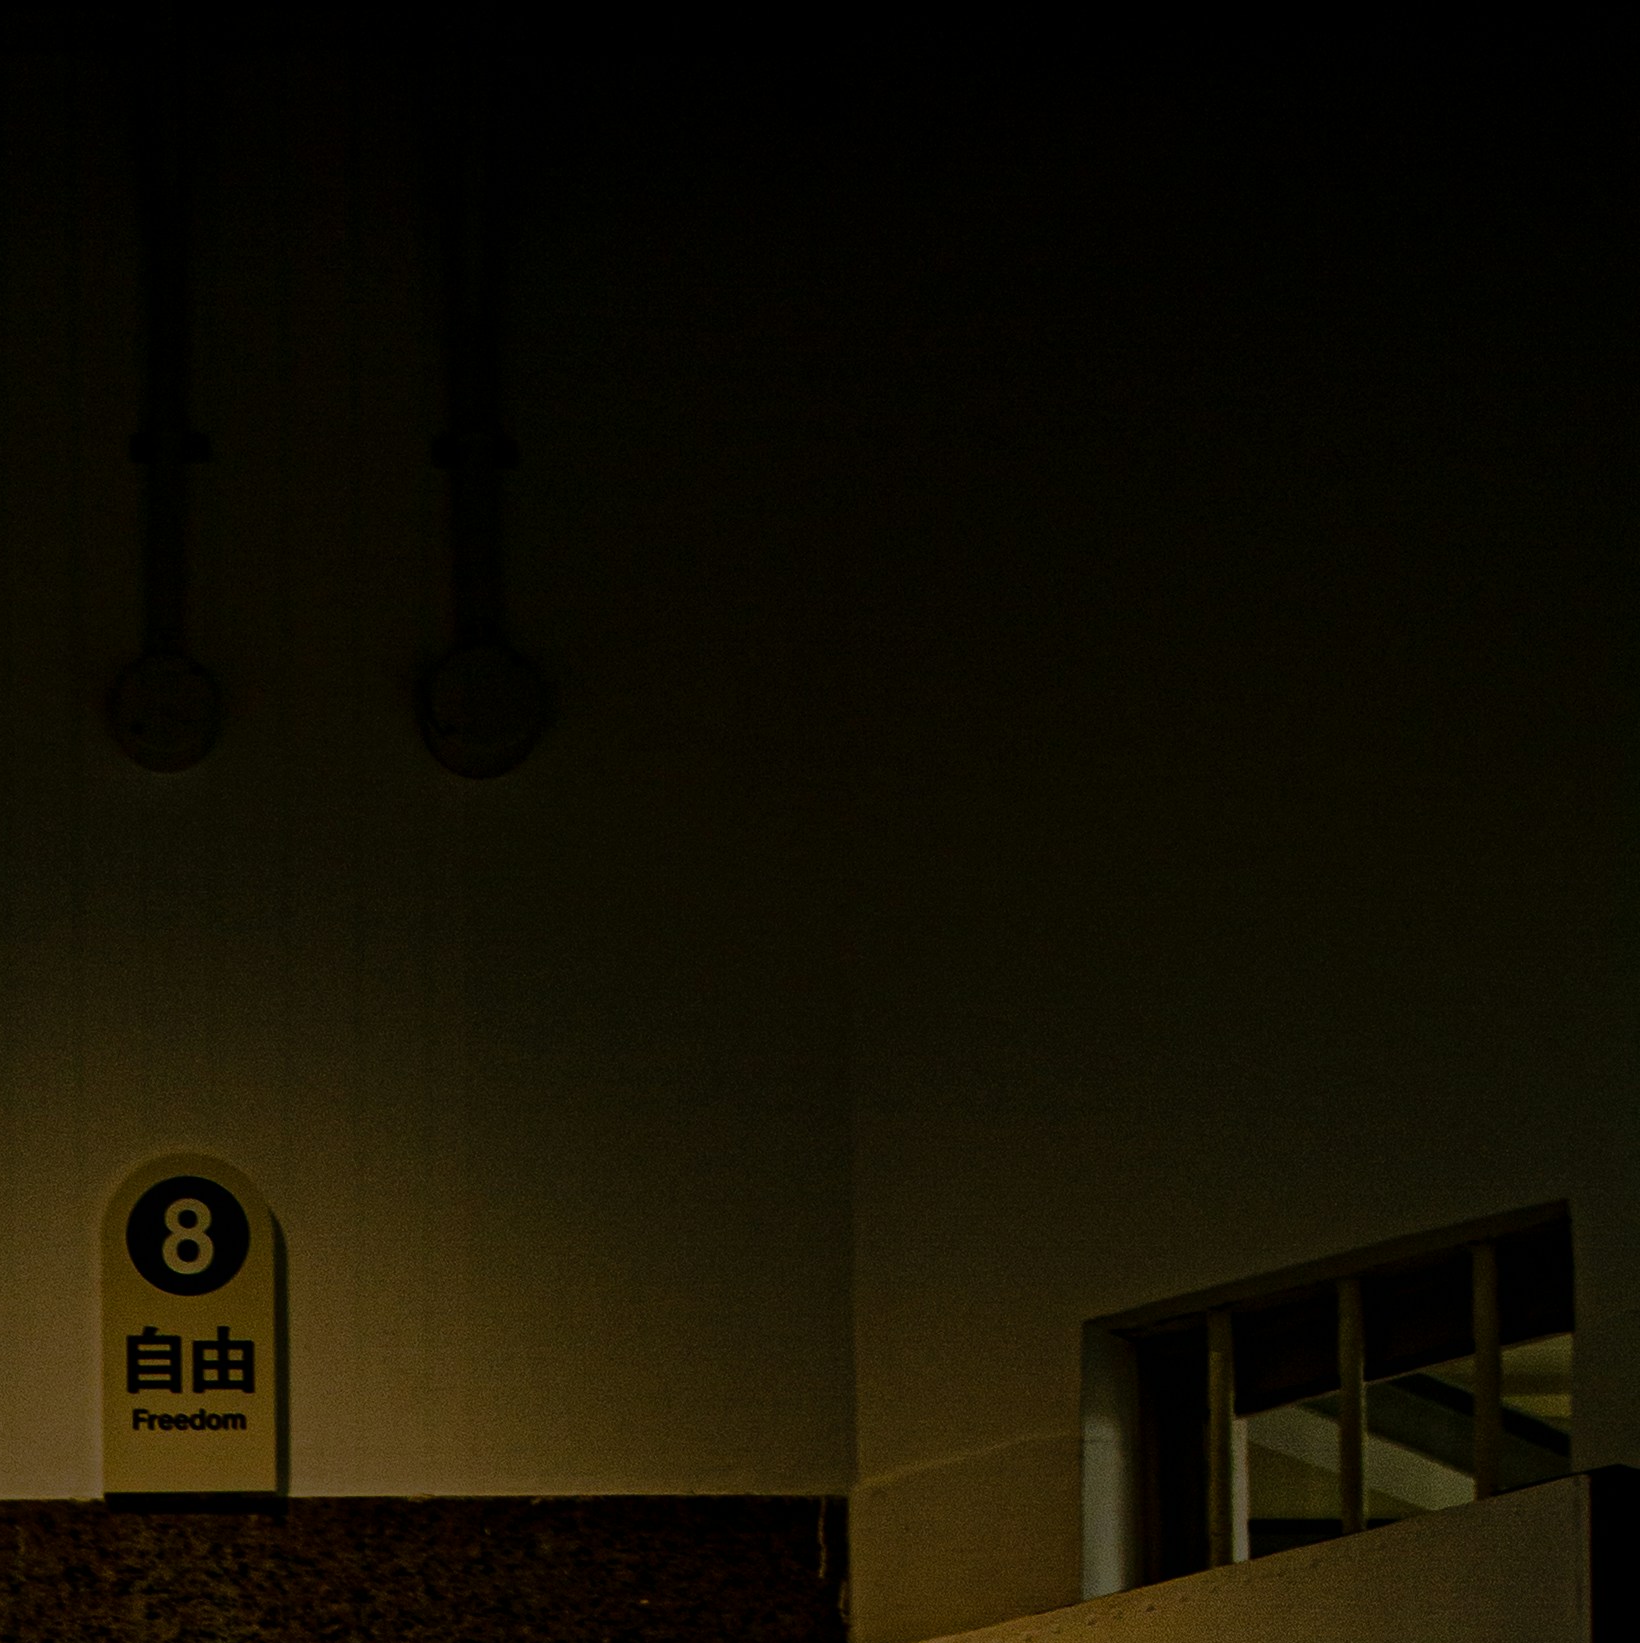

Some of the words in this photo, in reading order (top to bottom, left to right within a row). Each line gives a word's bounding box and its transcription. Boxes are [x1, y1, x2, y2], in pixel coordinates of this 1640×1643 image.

[162, 1198, 214, 1275] 8
[126, 1325, 255, 1394] 自由
[132, 1408, 247, 1431] Freedom
